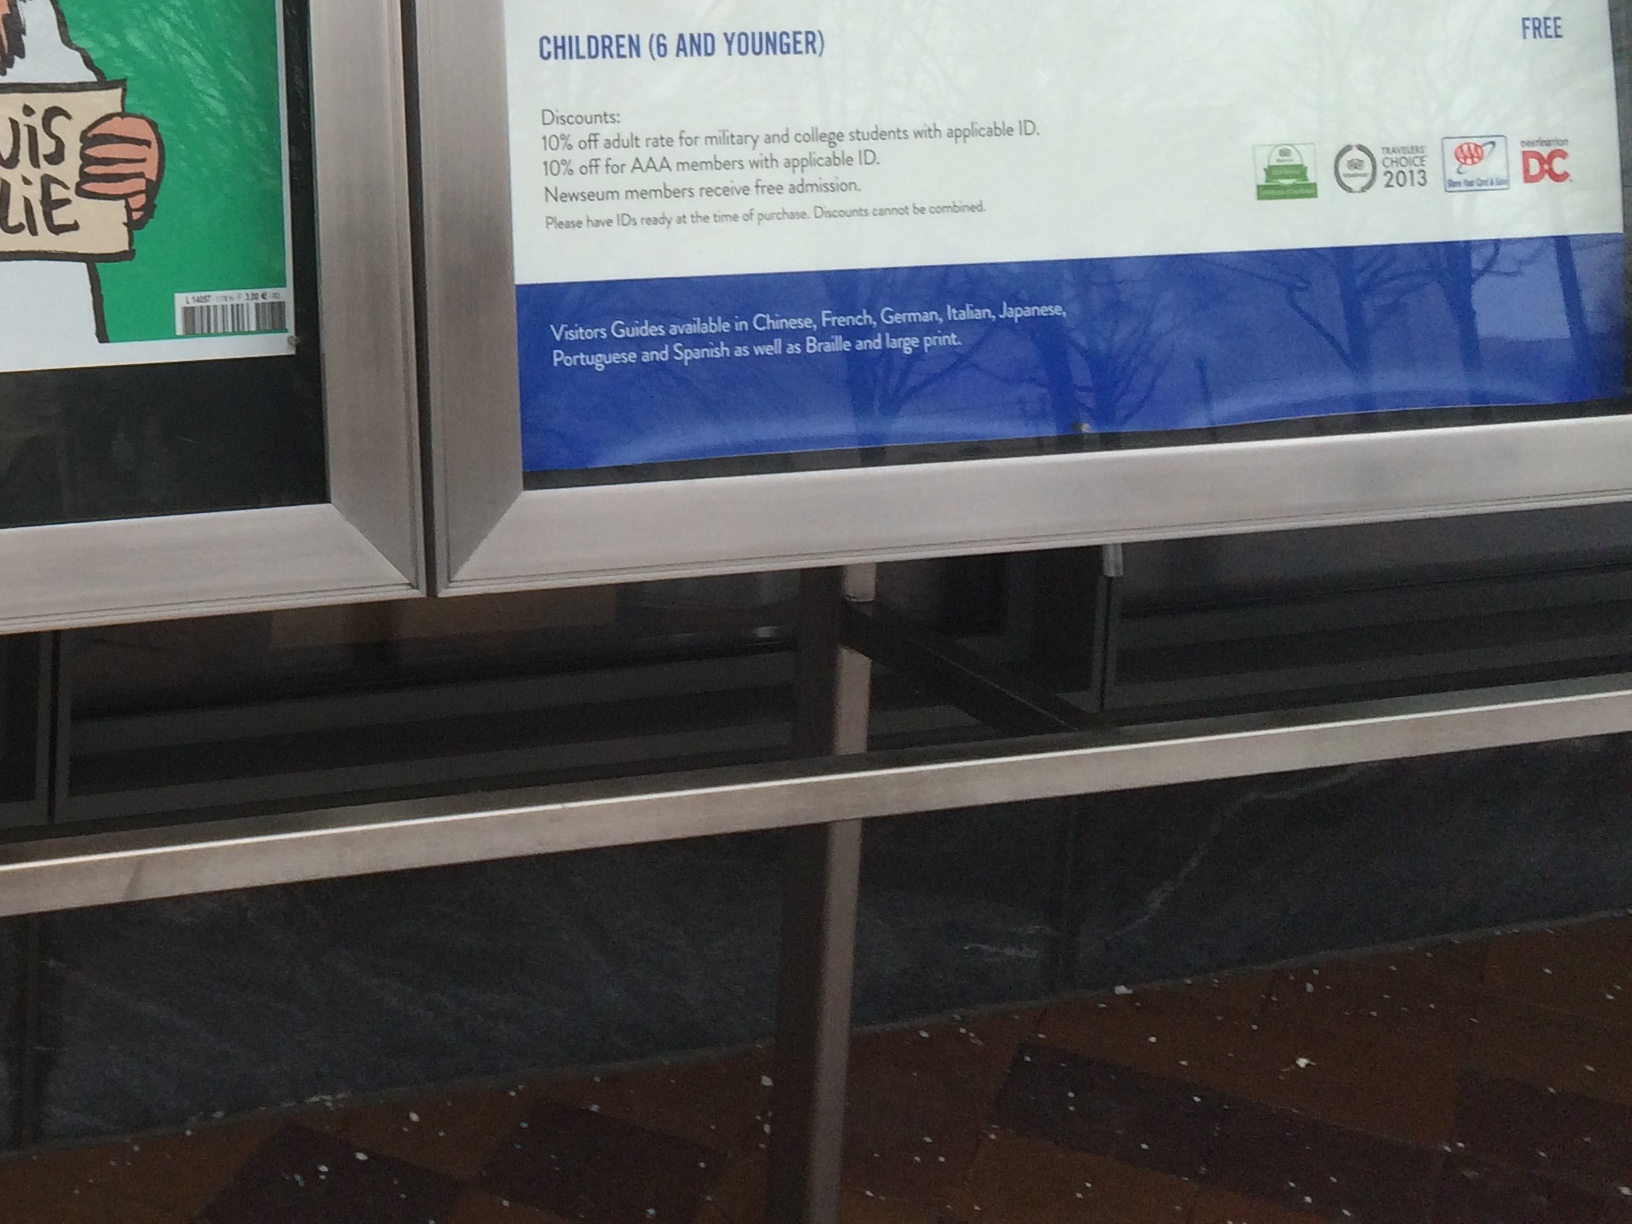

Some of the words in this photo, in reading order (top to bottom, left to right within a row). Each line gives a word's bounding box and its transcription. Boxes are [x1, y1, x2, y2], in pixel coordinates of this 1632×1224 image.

[1522, 16, 1563, 39] FREE
[539, 34, 641, 60] CHILDREN
[648, 33, 668, 60] (6
[675, 33, 715, 57] AND
[723, 31, 825, 56] YOUNGER)
[541, 109, 620, 126] Discounts:
[542, 133, 573, 151] 10%
[578, 132, 600, 150] off
[603, 132, 641, 149] adult
[645, 135, 674, 148] rate
[678, 130, 700, 147] for
[704, 129, 759, 149] military
[764, 128, 789, 144] and
[794, 127, 845, 146] college
[848, 125, 909, 141] students
[912, 123, 942, 139] with
[946, 121, 1015, 142] applicable
[1018, 119, 1040, 136] ID.
[1382, 156, 1426, 168] CHOICE
[1521, 148, 1571, 183] DC
[544, 186, 620, 203] Newseum
[624, 183, 695, 199] members
[699, 181, 751, 197] receive
[754, 179, 784, 195] free
[788, 177, 861, 194] admission.
[1384, 169, 1428, 188] 2013
[550, 324, 607, 341] Visitors
[610, 320, 665, 338] Guides
[668, 316, 731, 335] available
[734, 316, 749, 331] in
[752, 313, 817, 331] Chinese,
[821, 309, 877, 327] French,
[880, 307, 943, 324] German,
[946, 304, 996, 321] Italian,
[998, 302, 1067, 322] Japanese,
